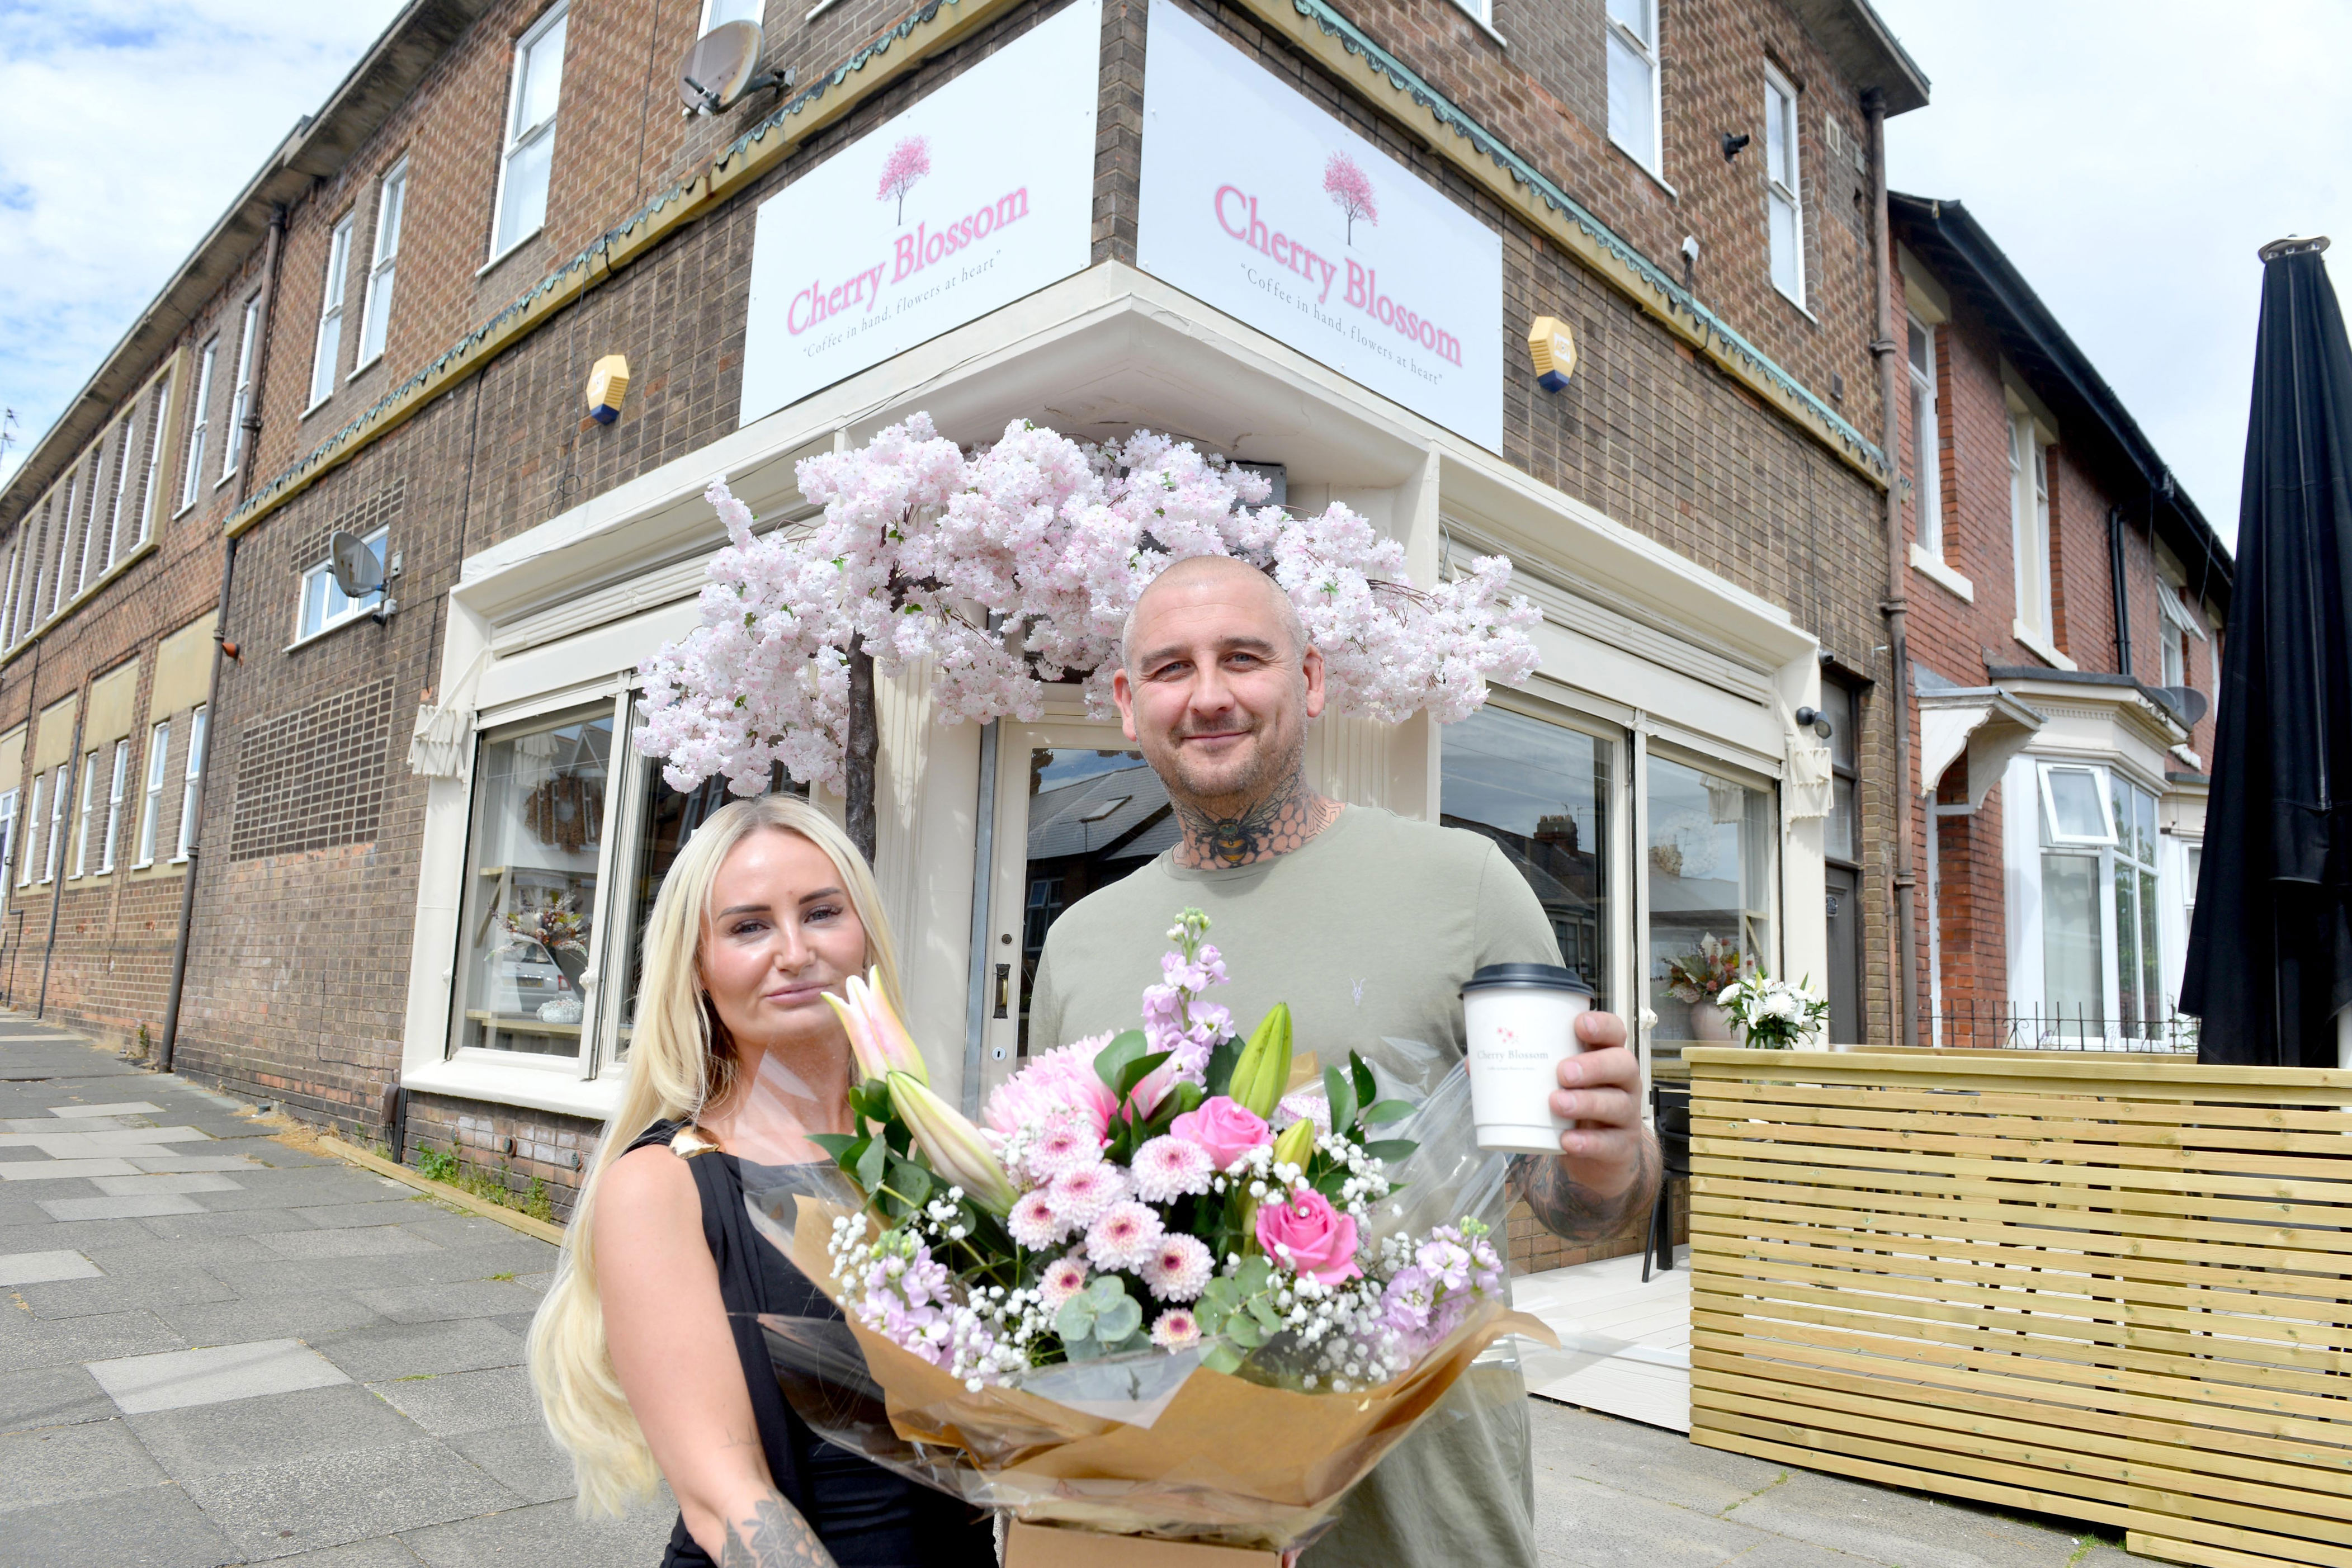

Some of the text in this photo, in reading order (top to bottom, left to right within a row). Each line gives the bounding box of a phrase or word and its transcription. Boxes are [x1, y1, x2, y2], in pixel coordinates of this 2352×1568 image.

[787, 187, 1028, 335] Cherry Blossom
[1215, 185, 1463, 367] Cherry Blossom
[847, 326, 857, 338] in
[862, 306, 891, 332] hand,
[896, 285, 940, 314] flowers
[945, 276, 956, 290] at
[1297, 296, 1309, 314] in
[1314, 304, 1346, 336] hand,
[1351, 325, 1392, 360] flowers
[1397, 356, 1406, 368] at
[1477, 1049, 1548, 1062] Cherry Blossom
